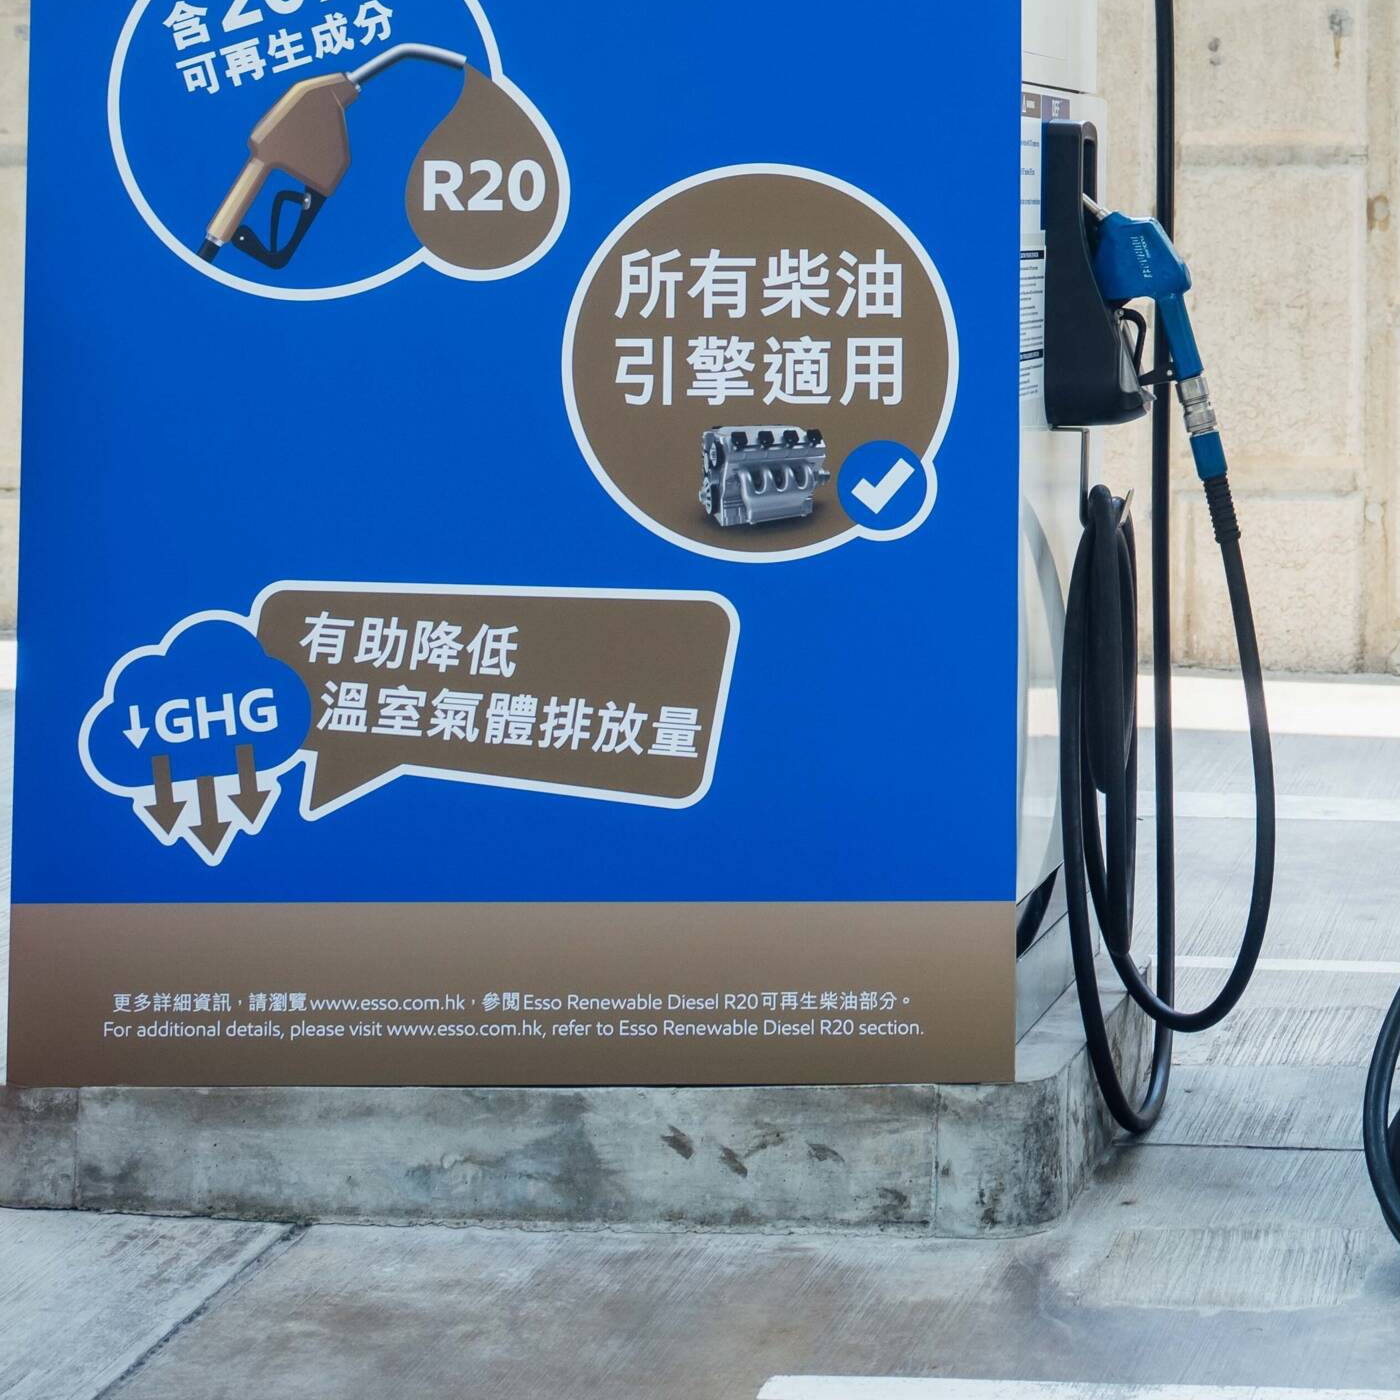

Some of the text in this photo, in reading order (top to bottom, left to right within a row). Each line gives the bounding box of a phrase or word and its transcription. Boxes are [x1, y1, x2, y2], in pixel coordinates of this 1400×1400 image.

[175, 0, 394, 95] 可再生成分
[423, 159, 547, 212] R20
[614, 249, 903, 319] 所有柴油
[614, 335, 903, 406] 引擎適用
[300, 610, 519, 679] 有助降低
[154, 687, 278, 744] GHG
[316, 680, 702, 758] 溫室氣體排放量
[103, 1018, 924, 1041] For additional details, please visit www.esso.com.hk, refer to Esso Renewable Diesel R20 section.
[567, 993, 663, 1011] Renewable
[667, 992, 719, 1010] Diesel
